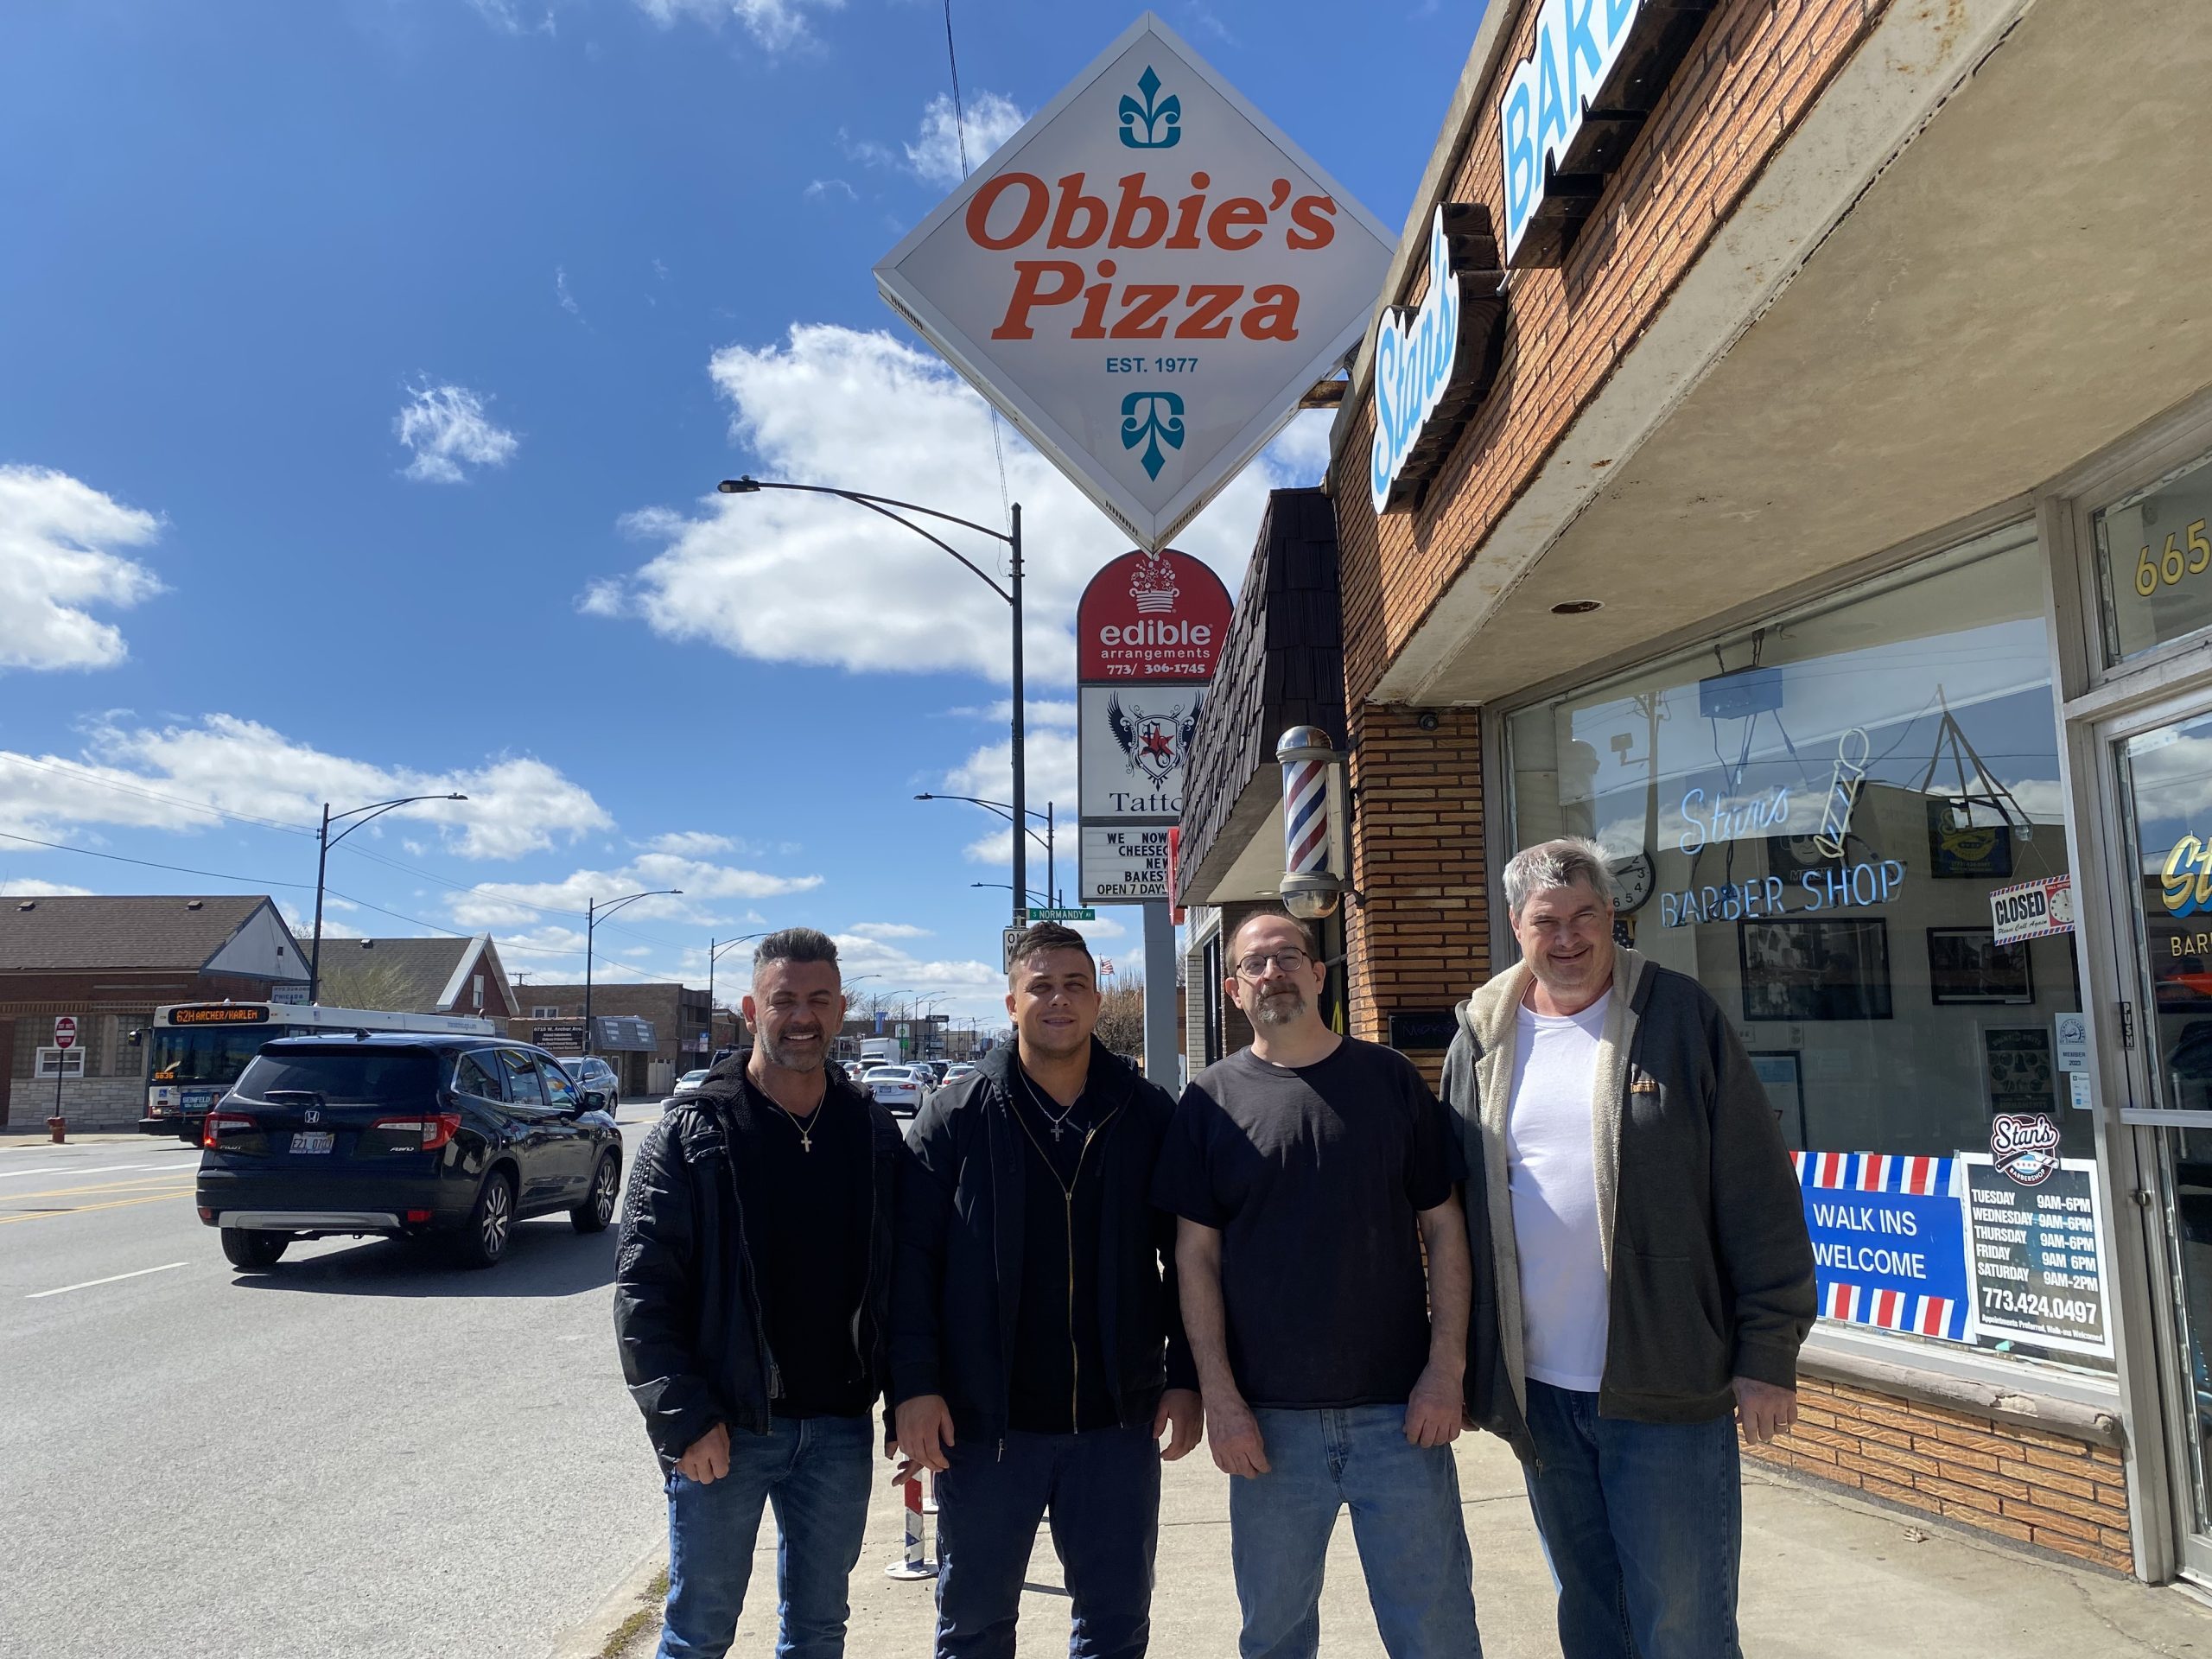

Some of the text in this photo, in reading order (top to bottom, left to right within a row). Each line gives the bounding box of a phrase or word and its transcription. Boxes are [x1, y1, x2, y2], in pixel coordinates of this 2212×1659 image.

[965, 171, 1337, 251] Obbie's
[990, 259, 1300, 341] Pizza
[1106, 358, 1198, 373] EST. 1977
[1375, 228, 1457, 495] Stan's
[2134, 518, 2211, 596] 665
[1099, 620, 1211, 646] edible
[1101, 648, 1210, 660] arrangements
[1106, 664, 1205, 676] 773/ 306-1745
[1680, 785, 1792, 855] Stan's
[1107, 832, 1167, 844] WE NOW
[1118, 846, 1168, 856] CHEESEC
[1096, 884, 1127, 894] OPEN
[1130, 884, 1136, 894] 7
[1124, 871, 1167, 882] BAKES
[1661, 860, 1905, 928] BARBER SHOP
[1039, 910, 1084, 919] NORMANDY
[1995, 891, 2046, 925] CLOSED
[2015, 922, 2027, 931] Call
[2030, 919, 2047, 928] Again
[2171, 933, 2212, 957] BAR
[176, 1009, 257, 1022] 62H ARCHER/HARLEM
[2123, 1003, 2134, 1046] PUSH
[1996, 1118, 2054, 1149] Stan's
[2009, 1167, 2045, 1181] BARBERSHOP
[1971, 1189, 2091, 1212] TUESDAY 9AM-6PM
[1813, 1203, 1917, 1236] WALK INS
[1973, 1207, 2093, 1232] WEDNESDAY 9AM-6PM
[1974, 1225, 2094, 1252] THURSDAY 9AM-6PM
[1811, 1242, 1927, 1279] WELCOME
[1976, 1243, 2011, 1261] FRIDAY
[1977, 1262, 2098, 1292] SATURDAY 9AM-2PM
[1982, 1287, 2097, 1325] 773.424.0497
[1982, 1314, 2018, 1327] Appointments
[2072, 1329, 2103, 1342] Welcomed
